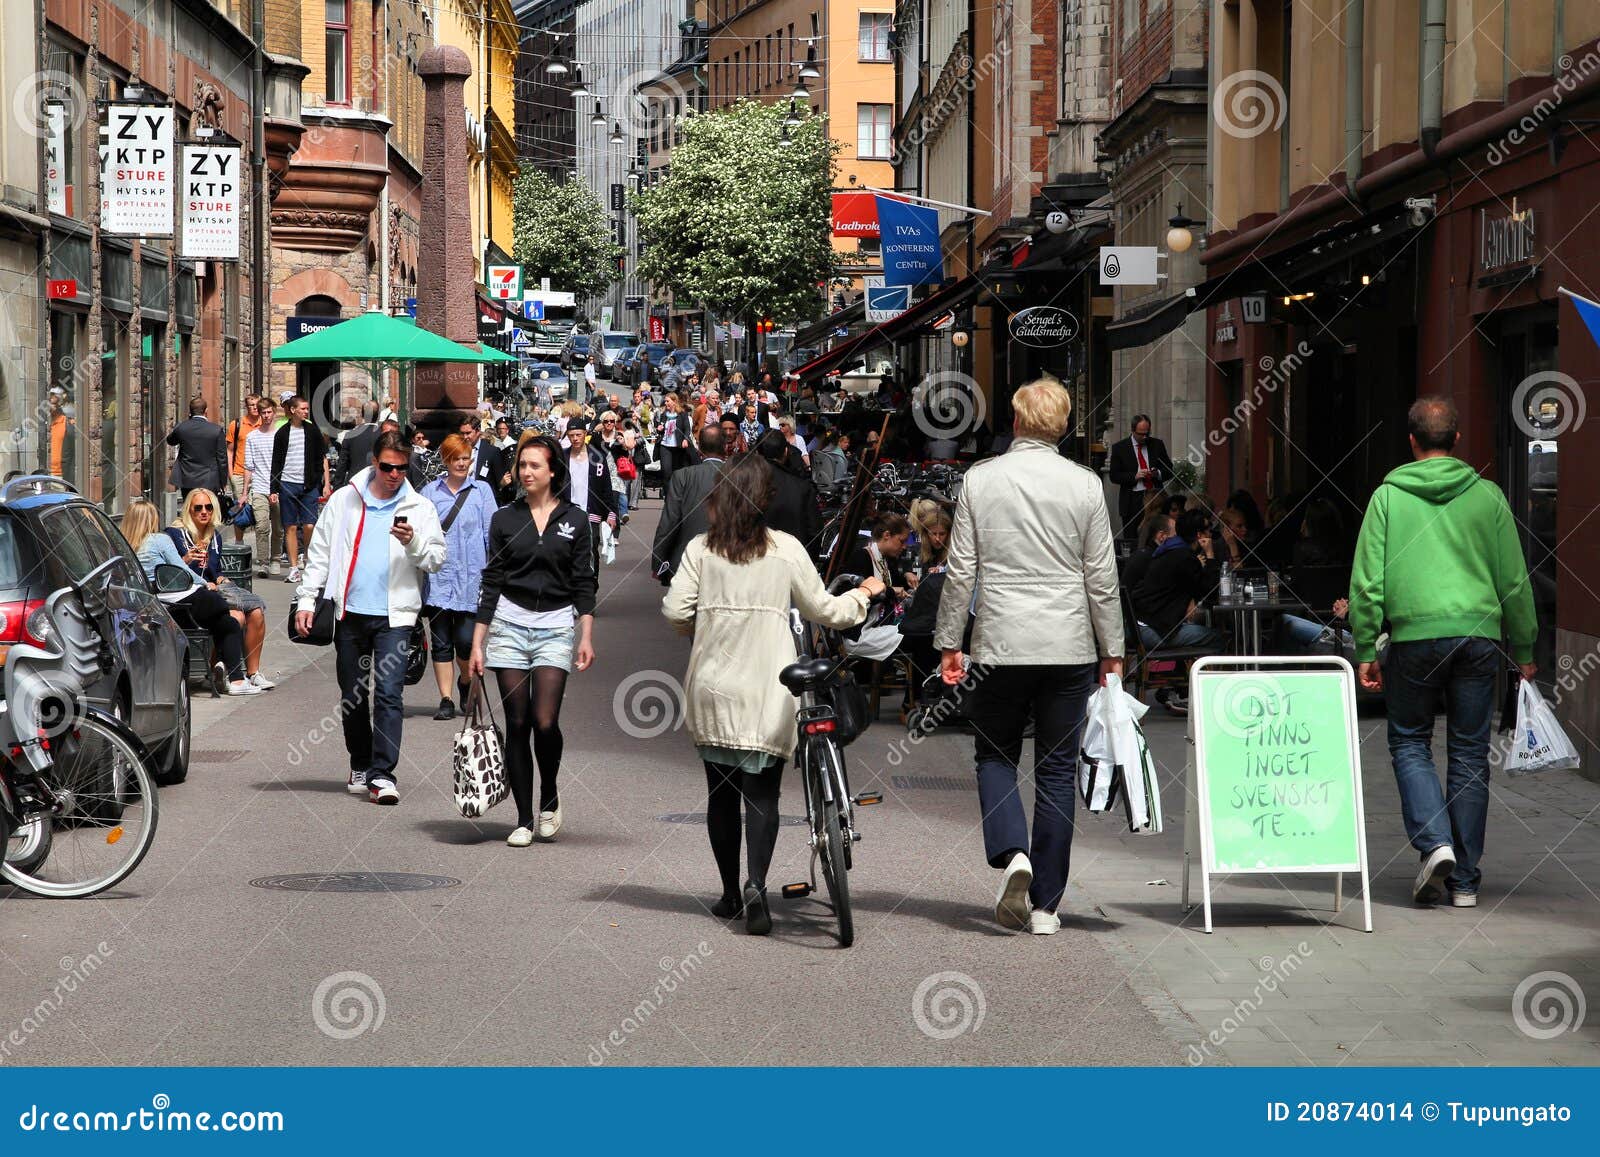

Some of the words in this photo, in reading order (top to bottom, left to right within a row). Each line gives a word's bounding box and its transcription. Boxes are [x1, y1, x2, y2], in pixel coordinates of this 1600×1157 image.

[117, 114, 165, 140] ZY
[116, 148, 165, 164] KTP
[190, 154, 232, 175] ZY
[117, 170, 166, 180] STURE
[116, 187, 166, 195] HVTSKP
[190, 183, 232, 197] KTP
[190, 202, 232, 211] STURE
[1051, 214, 1063, 225] 12
[1246, 300, 1262, 317] 10
[1025, 312, 1063, 329] Sengel's
[1015, 324, 1073, 341] Guldsmedja
[596, 463, 604, 477] B
[1250, 691, 1302, 717] DET
[1243, 720, 1312, 747] FINNS
[1245, 751, 1319, 778] INGET
[1230, 780, 1335, 809] SVENSKT
[1252, 813, 1315, 840] TE...
